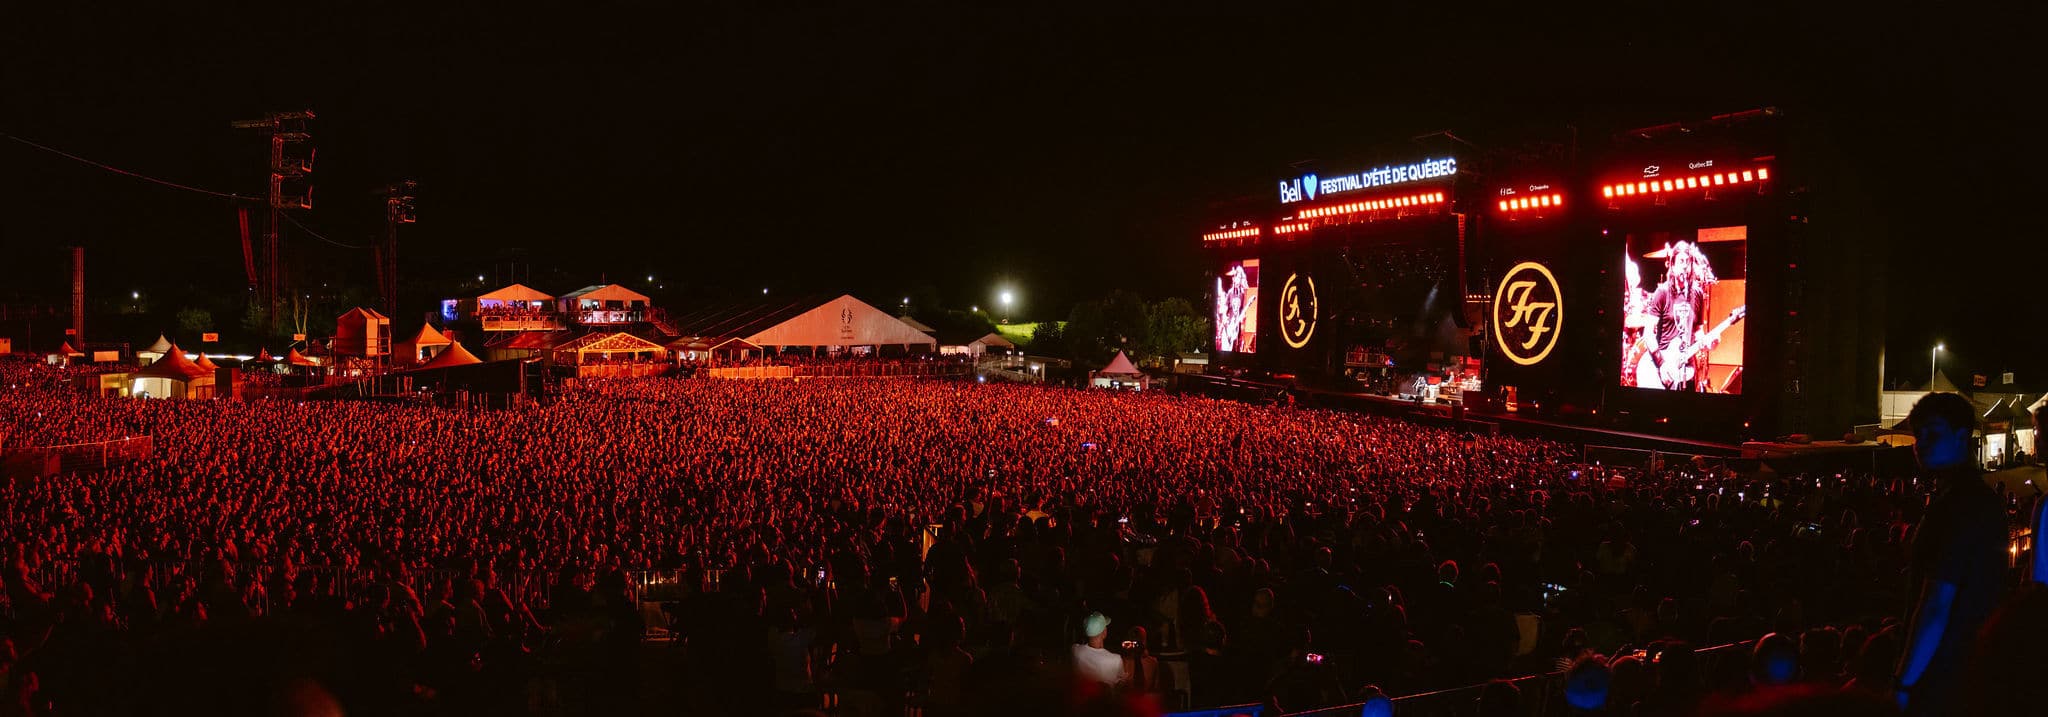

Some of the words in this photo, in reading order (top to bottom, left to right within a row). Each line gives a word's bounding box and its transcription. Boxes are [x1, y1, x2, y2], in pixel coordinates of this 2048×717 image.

[1279, 178, 1302, 204] Bell
[1320, 174, 1363, 195] FESTIVAL
[1363, 165, 1392, 188] D'ÉTÉ
[1393, 165, 1408, 184] DE
[1408, 157, 1457, 182] QUÉBEC
